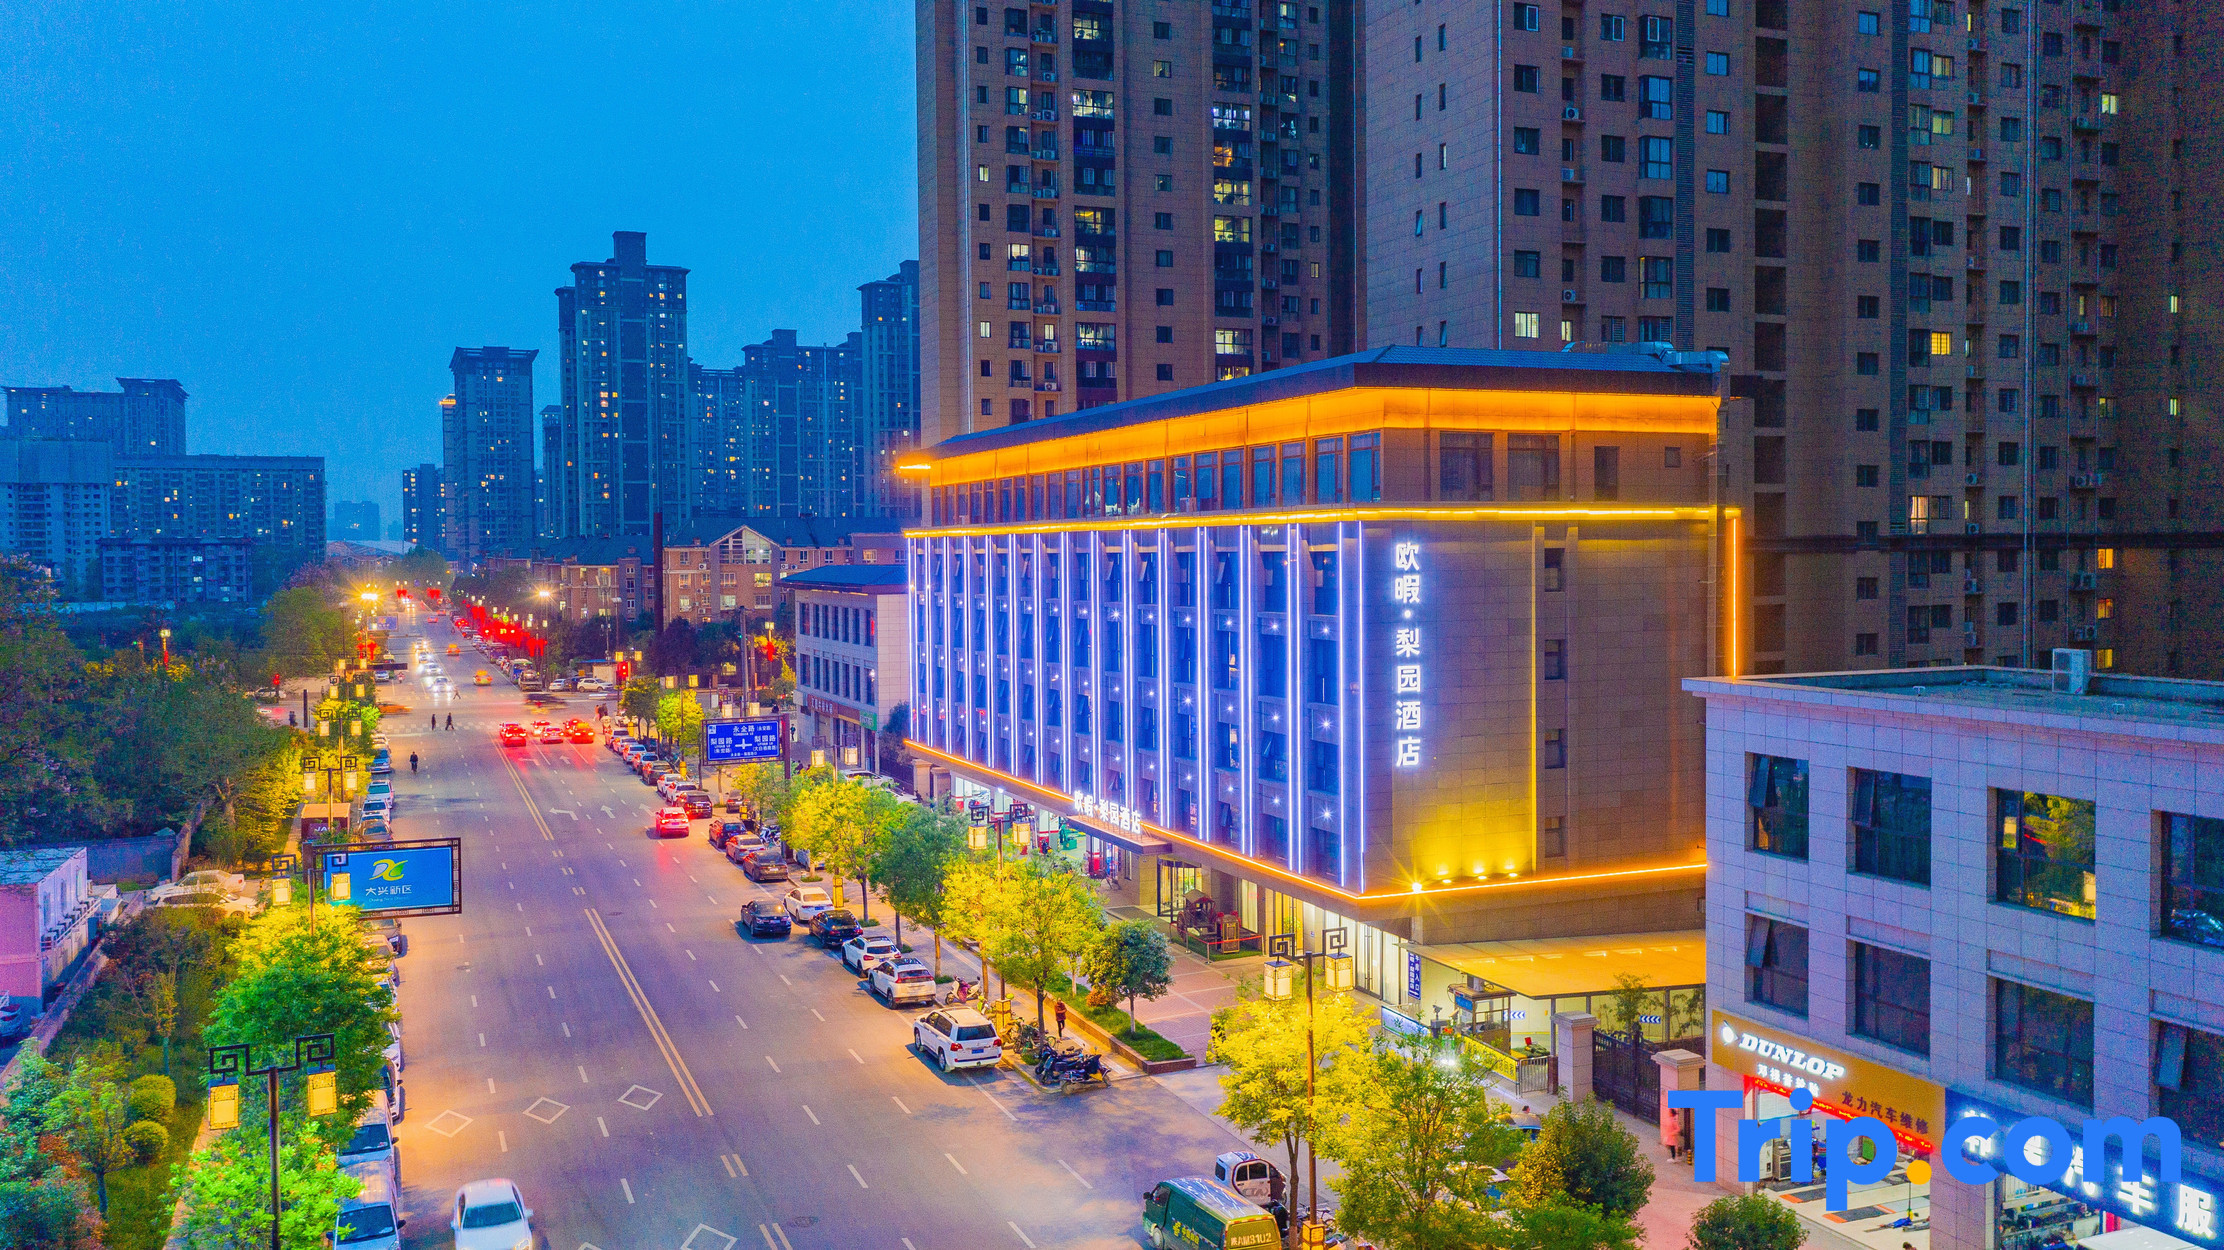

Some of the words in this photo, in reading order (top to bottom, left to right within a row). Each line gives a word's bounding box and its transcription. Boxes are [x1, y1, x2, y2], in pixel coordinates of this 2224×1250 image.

[1395, 541, 1421, 768] 欧暇·梨园酒店
[365, 885, 412, 896] 大兴新区
[1738, 1032, 1846, 1080] DUNLOP
[1840, 1090, 1930, 1135] 龙力汽车维修
